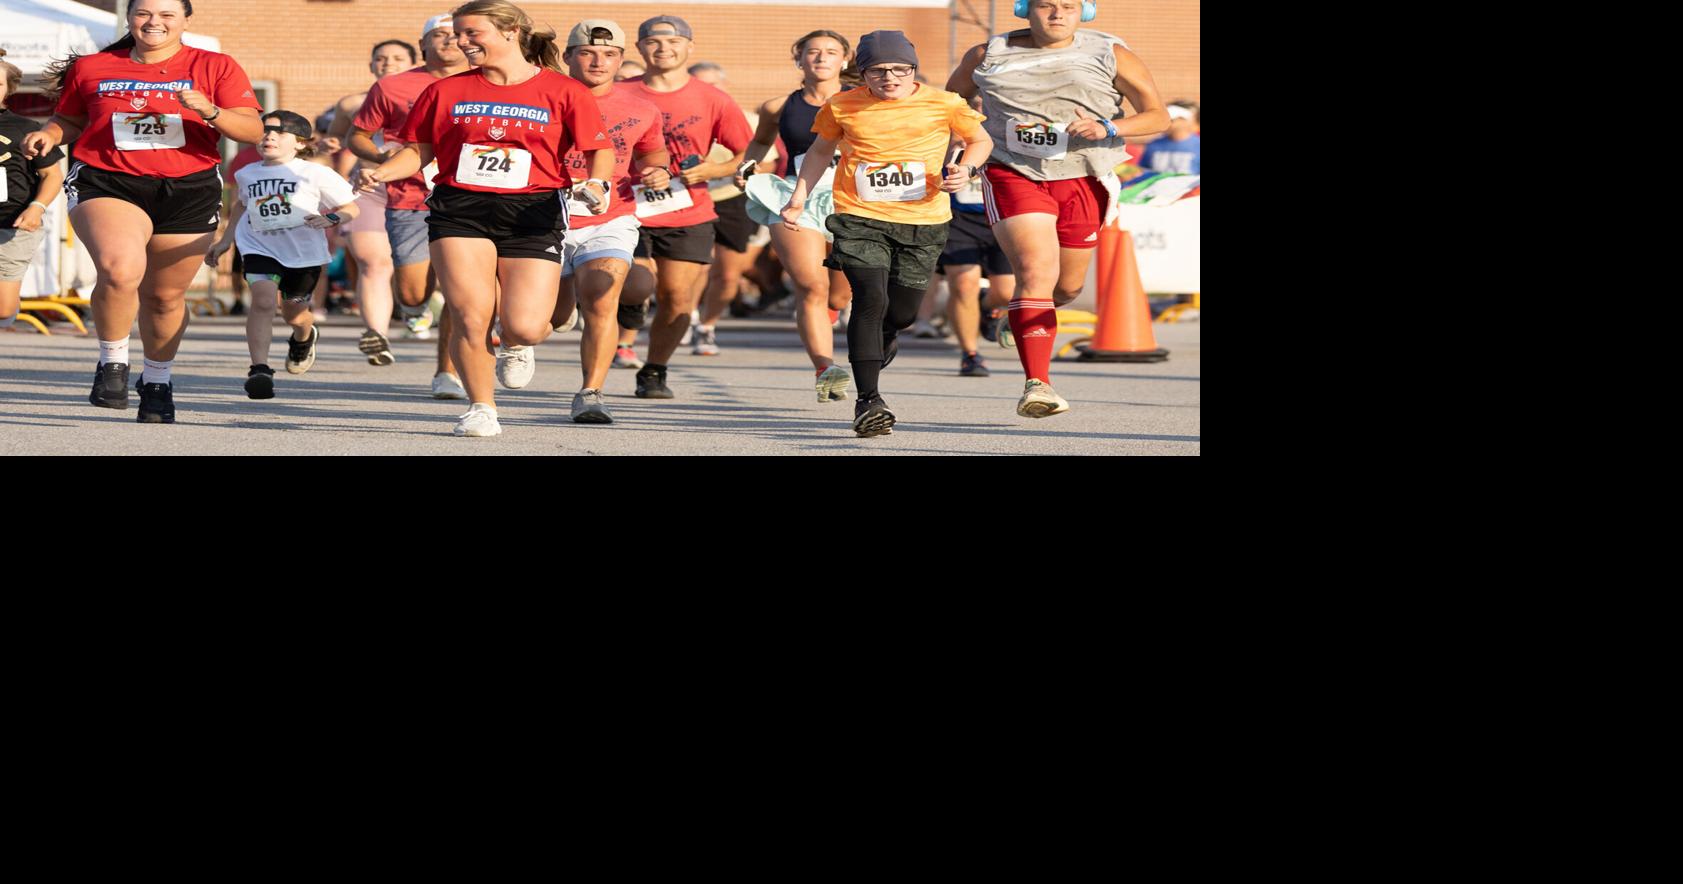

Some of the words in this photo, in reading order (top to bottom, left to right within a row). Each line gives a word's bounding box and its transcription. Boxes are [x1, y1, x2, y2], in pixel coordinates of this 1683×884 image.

[99, 82, 132, 91] WEST
[455, 104, 489, 114] WEST
[492, 105, 548, 122] GEORGIA
[131, 122, 166, 135] 725
[454, 117, 544, 132] SOFTBALL
[1015, 129, 1058, 146] 1359
[478, 156, 511, 173] 724
[866, 171, 914, 187] 1340
[259, 202, 292, 217] 693
